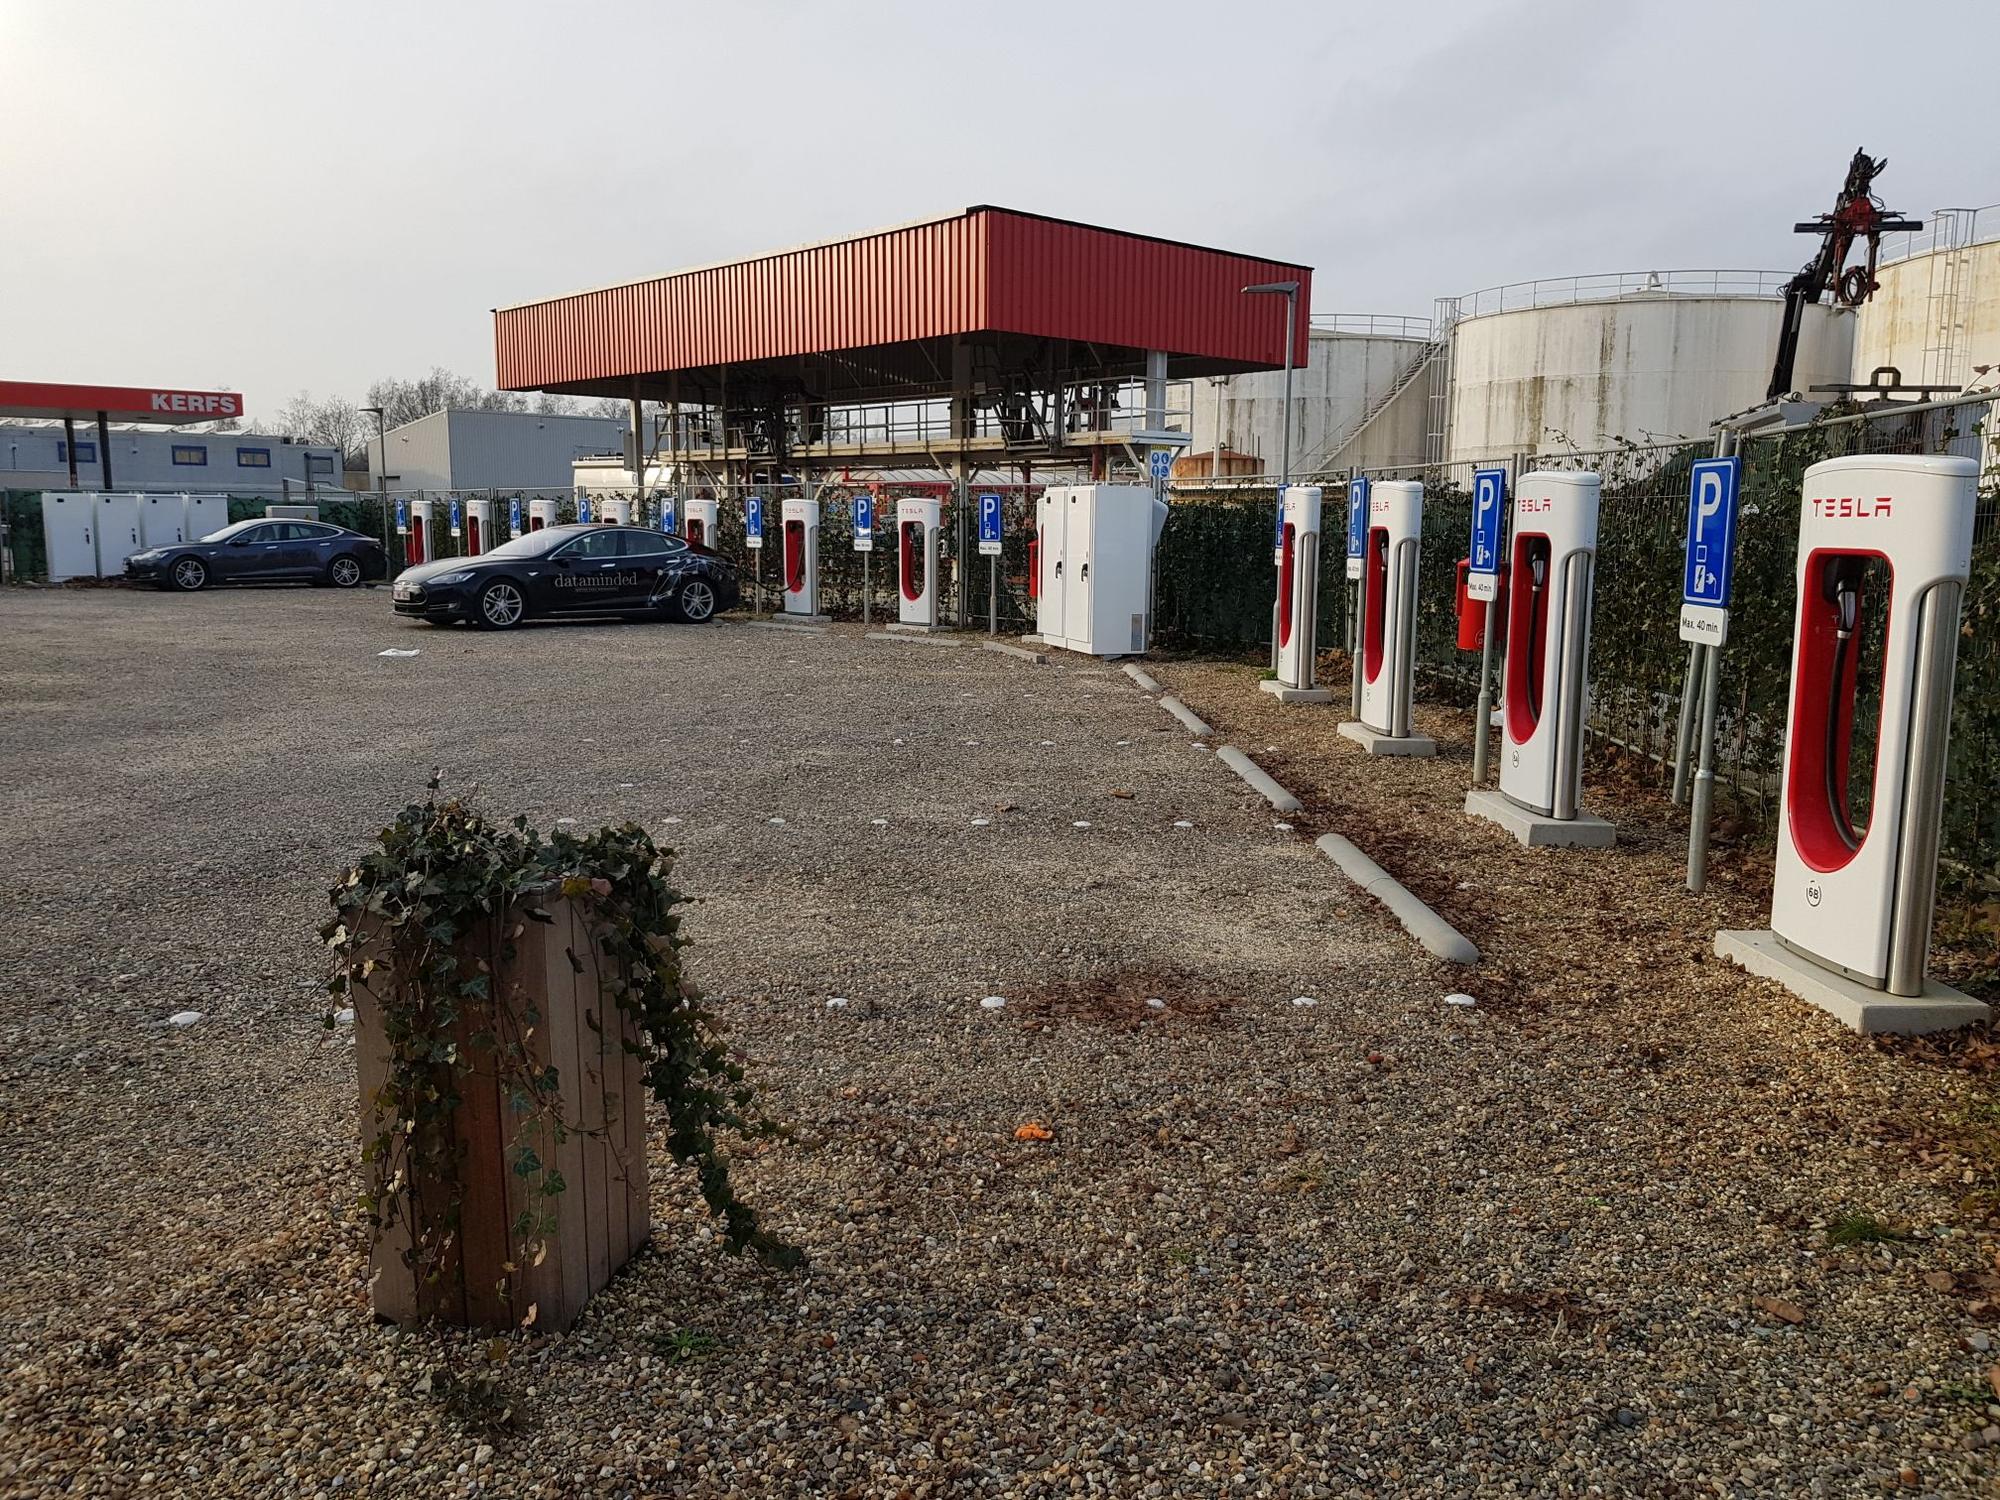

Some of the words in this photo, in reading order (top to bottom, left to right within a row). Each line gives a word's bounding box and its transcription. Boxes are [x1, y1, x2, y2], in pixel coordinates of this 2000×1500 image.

[152, 393, 236, 413] KERFS
[749, 500, 757, 520] P
[858, 500, 867, 522] P
[984, 499, 995, 522] P
[1351, 486, 1361, 524] P
[1373, 501, 1390, 512] ESLA
[1476, 479, 1494, 529] P
[1518, 499, 1550, 512] TESLA
[1696, 472, 1722, 542] P
[1813, 497, 1892, 517] TESLA
[554, 571, 637, 588] dataminded
[1682, 616, 1695, 629] Max.
[1697, 619, 1705, 631] 40
